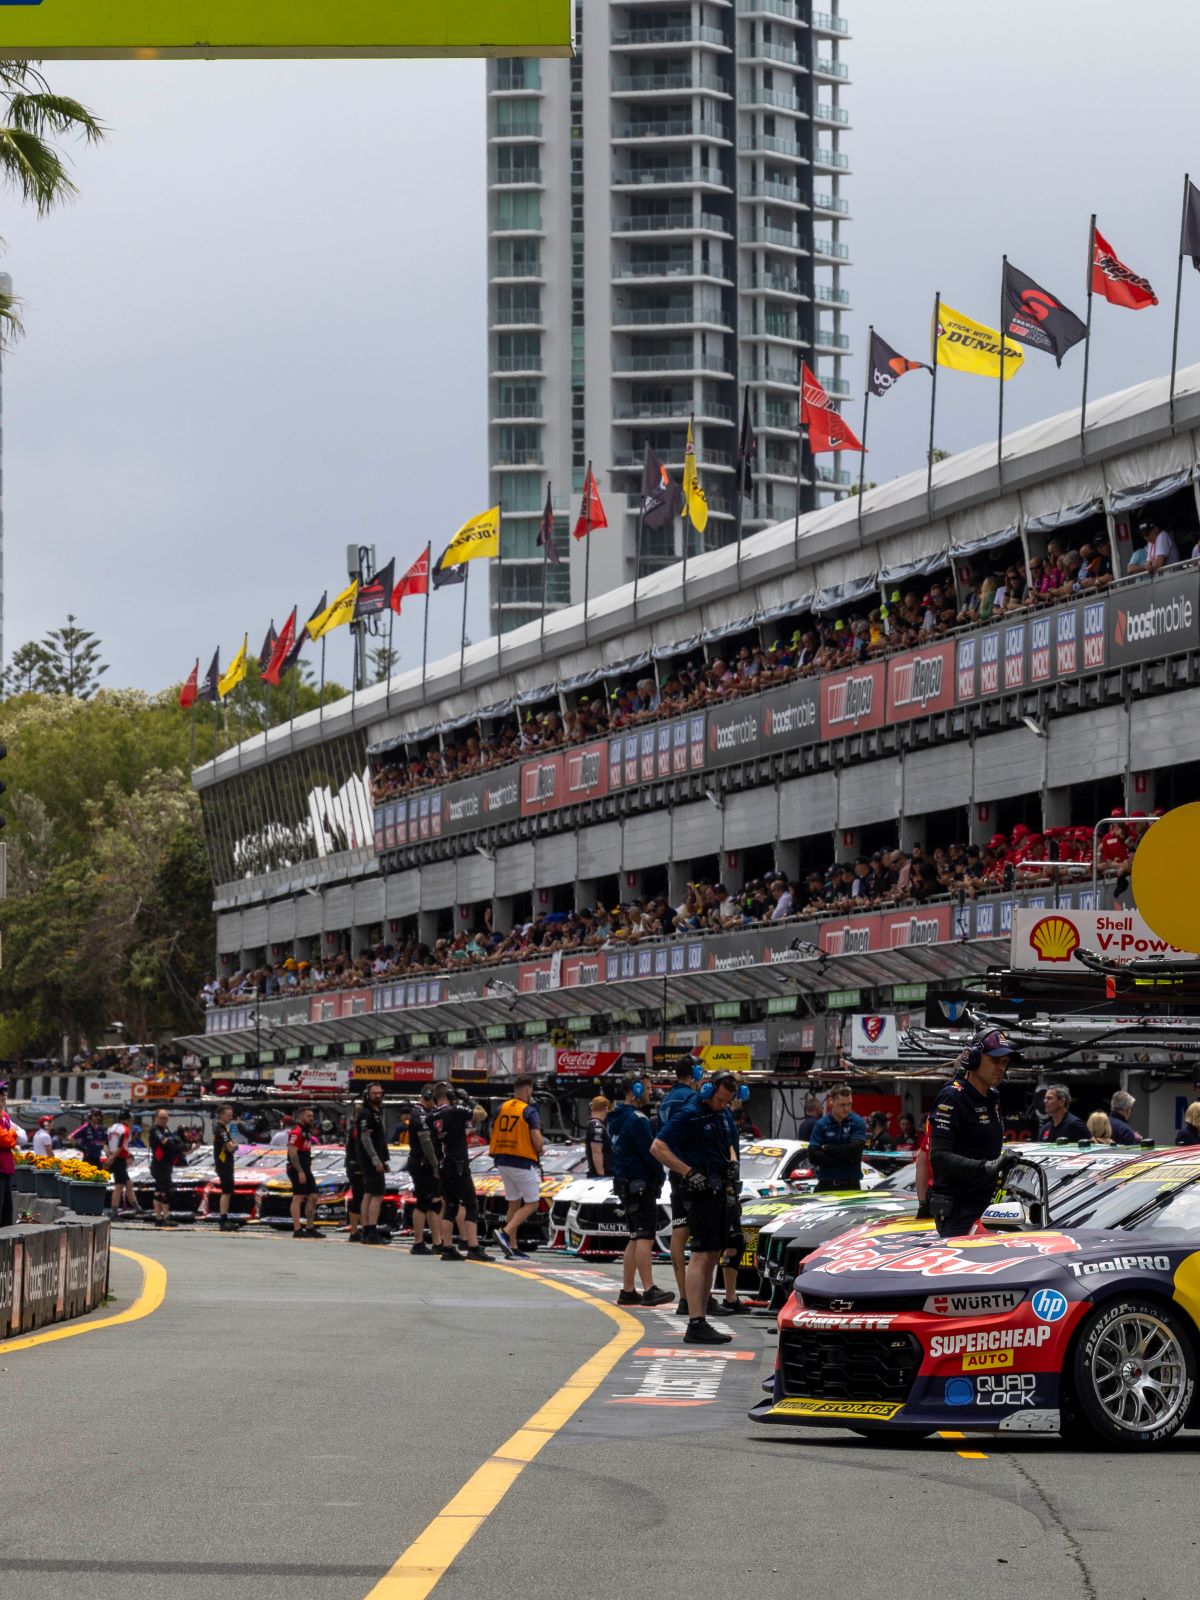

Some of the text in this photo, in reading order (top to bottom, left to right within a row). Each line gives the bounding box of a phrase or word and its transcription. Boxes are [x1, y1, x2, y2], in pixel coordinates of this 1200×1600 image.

[946, 322, 993, 341] STICK WITH
[946, 331, 1022, 358] DUNLOP
[1096, 917, 1133, 931] Shell
[1097, 934, 1182, 953] V-Pow
[982, 1210, 1019, 1218] ACDelco
[1068, 1256, 1170, 1277] ToolPRO
[1037, 1289, 1063, 1321] hp
[792, 1310, 894, 1329] COMPLETE
[1085, 1303, 1129, 1356] DUNLOP
[930, 1326, 1050, 1357] SUPERCHEAP
[967, 1354, 1009, 1366] AUTO
[976, 1374, 1036, 1390] QUAD
[976, 1391, 1036, 1406] LOCK
[821, 1402, 893, 1415] STORAGE
